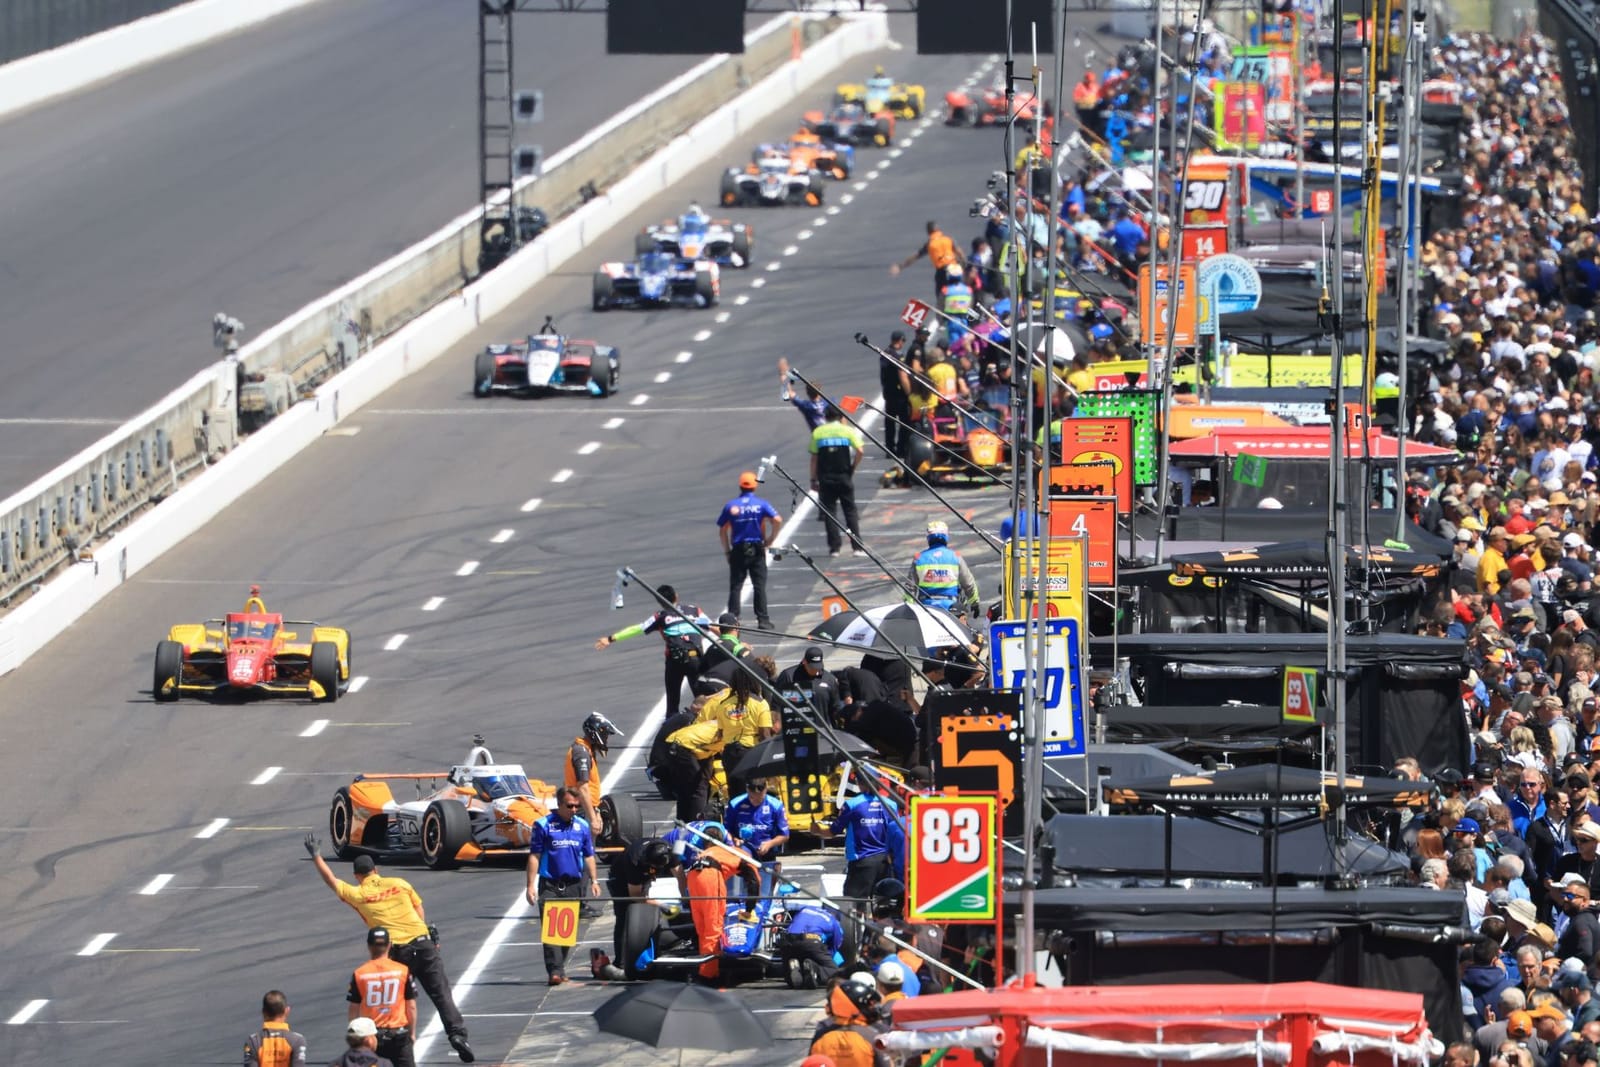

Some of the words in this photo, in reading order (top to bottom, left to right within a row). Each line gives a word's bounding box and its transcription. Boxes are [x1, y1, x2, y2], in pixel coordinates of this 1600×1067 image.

[1184, 181, 1224, 210] 30
[1195, 236, 1215, 255] 14
[901, 303, 926, 328] 14
[1071, 513, 1088, 537] 4
[1287, 679, 1302, 710] 83
[941, 714, 1015, 815] 5
[922, 808, 981, 863] 83
[547, 906, 575, 939] 10
[366, 978, 400, 1007] 60
